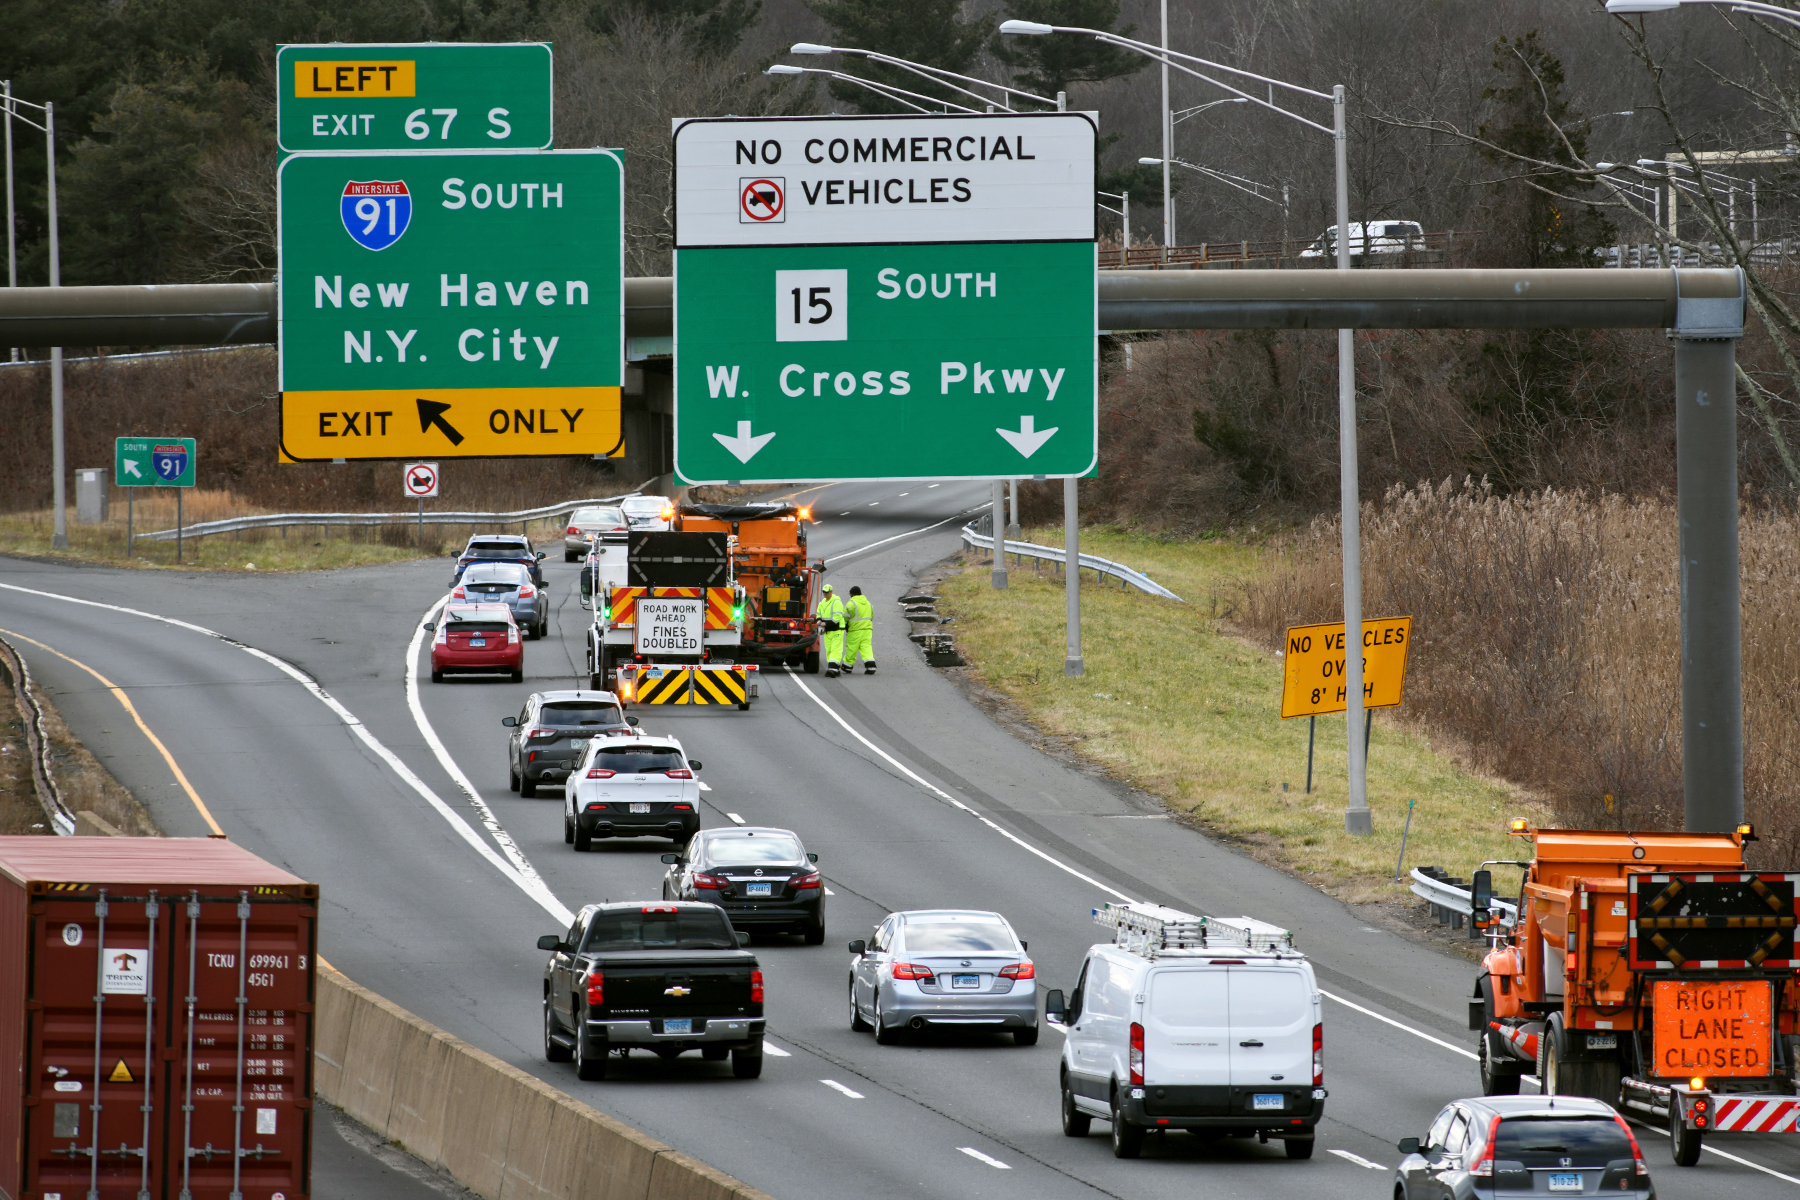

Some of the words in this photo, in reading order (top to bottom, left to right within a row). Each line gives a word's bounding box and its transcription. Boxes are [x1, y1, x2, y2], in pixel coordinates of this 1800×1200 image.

[313, 66, 398, 92] LEFT
[312, 114, 375, 136] EXIT
[404, 108, 458, 140] 67
[486, 107, 512, 139] S
[735, 140, 782, 164] NO
[804, 135, 1036, 163] COMMERCIAL
[351, 184, 401, 194] INTERSTATE
[441, 178, 563, 210] SOUTH
[801, 177, 972, 205] VEHICLES
[355, 198, 396, 236] 91
[314, 275, 410, 308] New
[440, 273, 590, 307] Haven
[876, 267, 997, 299] SOUTH
[791, 287, 833, 324] 15
[344, 329, 428, 363] N.Y.
[458, 328, 560, 369] City
[705, 365, 749, 398] W.
[779, 363, 911, 397] Cross
[940, 361, 1066, 401] Pkwy
[319, 411, 393, 437] EXIT
[489, 408, 585, 434] ONLY
[123, 443, 148, 451] SOUTH
[161, 459, 180, 476] 91
[643, 605, 668, 613] ROAD
[672, 605, 697, 614] WORK
[655, 614, 686, 623] AHEAD
[653, 626, 687, 637] FINES
[1289, 635, 1312, 654] NO
[1324, 627, 1405, 650] VECLES
[643, 638, 698, 649] DOUBLED
[1322, 657, 1367, 677] OV
[1311, 687, 1326, 704] 8'
[1336, 682, 1374, 702] HH
[207, 953, 235, 968] TCKU
[249, 955, 289, 969] 699961
[298, 955, 307, 969] 3
[247, 973, 274, 987] 45G1
[1676, 989, 1747, 1011] RIGHT
[1680, 1019, 1744, 1039] LANE
[199, 1037, 216, 1045] TARE
[197, 1063, 210, 1071] NET
[1665, 1048, 1759, 1068] CLOSED
